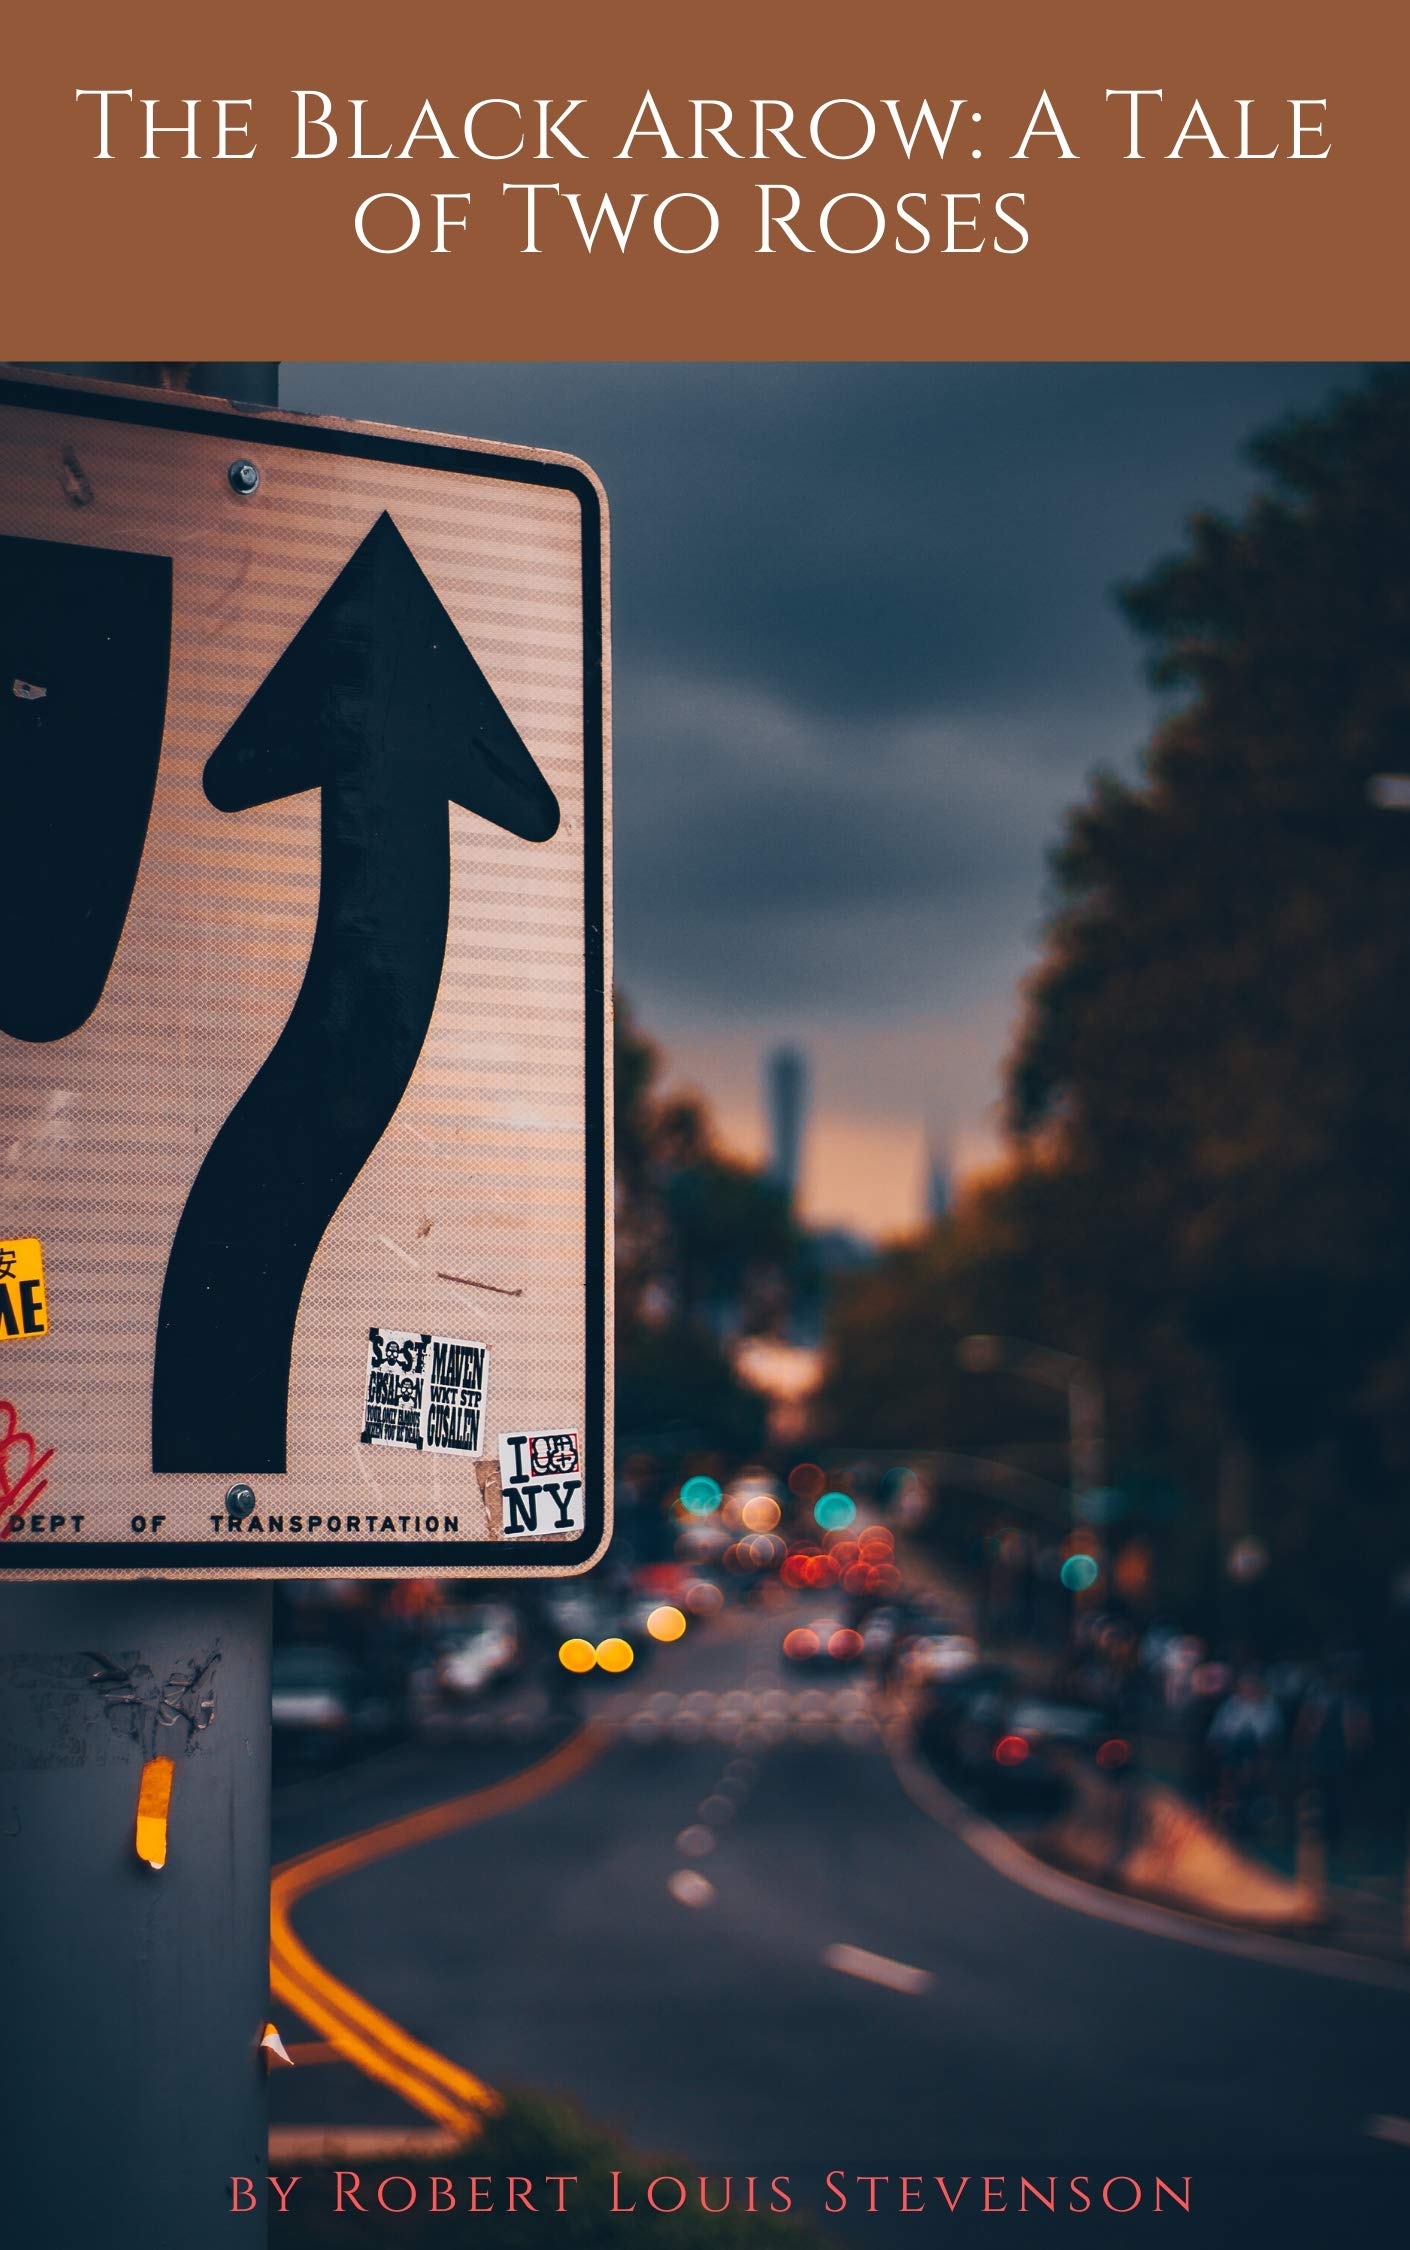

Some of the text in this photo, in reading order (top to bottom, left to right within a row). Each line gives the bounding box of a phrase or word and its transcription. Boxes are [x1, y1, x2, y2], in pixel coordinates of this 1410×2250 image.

[430, 1342, 486, 1390] MAVEN
[8, 1514, 460, 1533] DEPT OF TRANSPORTATION
[502, 1480, 582, 1535] NY
